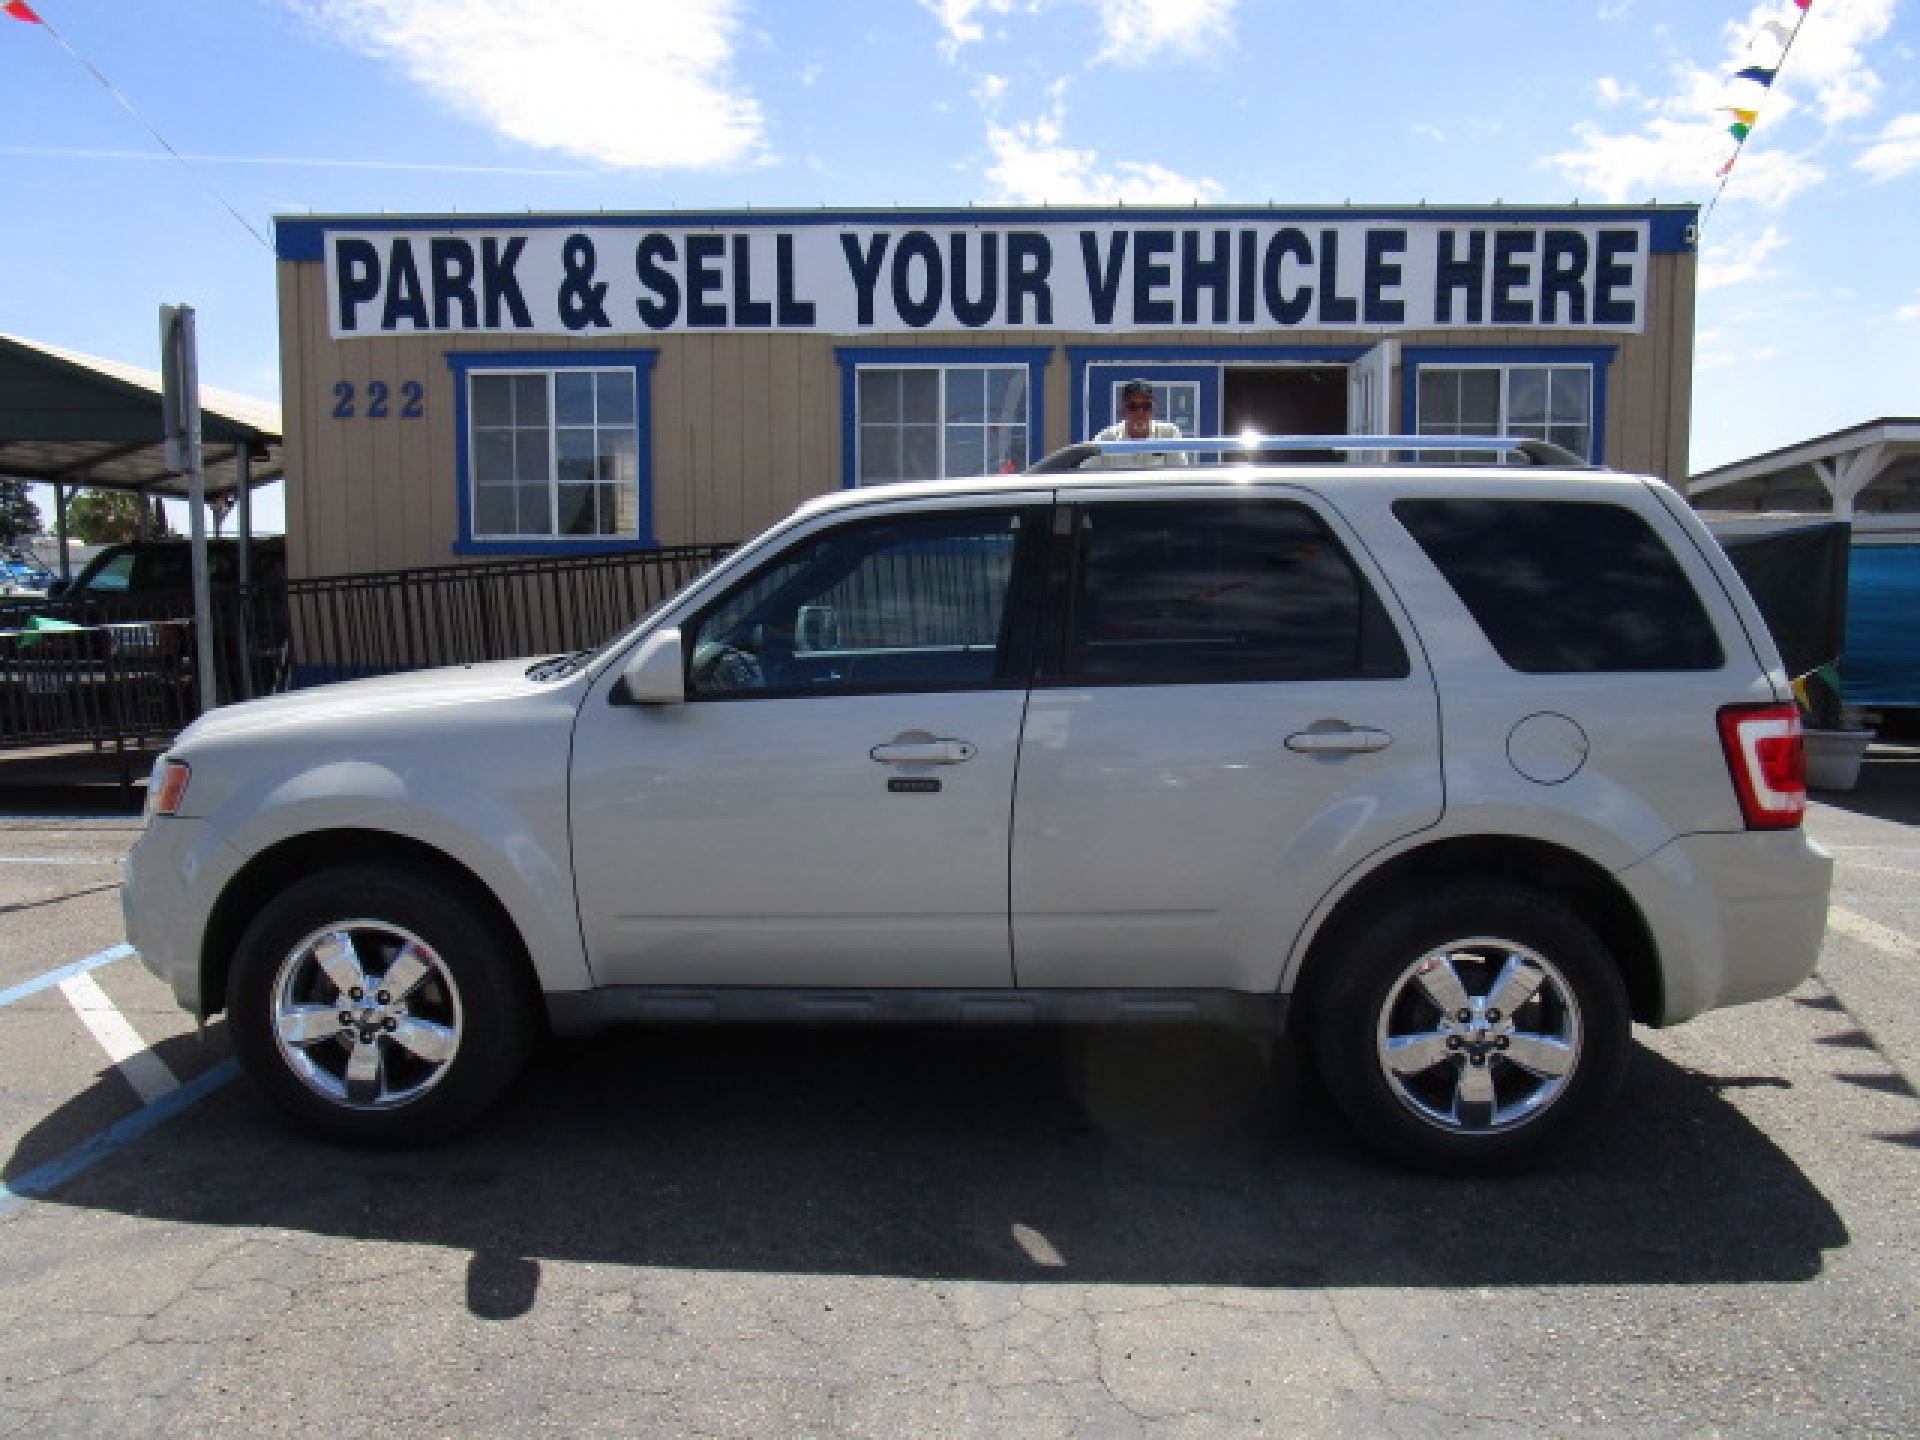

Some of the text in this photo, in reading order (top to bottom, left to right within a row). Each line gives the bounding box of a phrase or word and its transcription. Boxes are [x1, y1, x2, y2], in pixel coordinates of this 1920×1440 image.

[336, 228, 1638, 330] PARK & SELL YOUR VEHICLE HERE
[332, 380, 424, 418] 222
